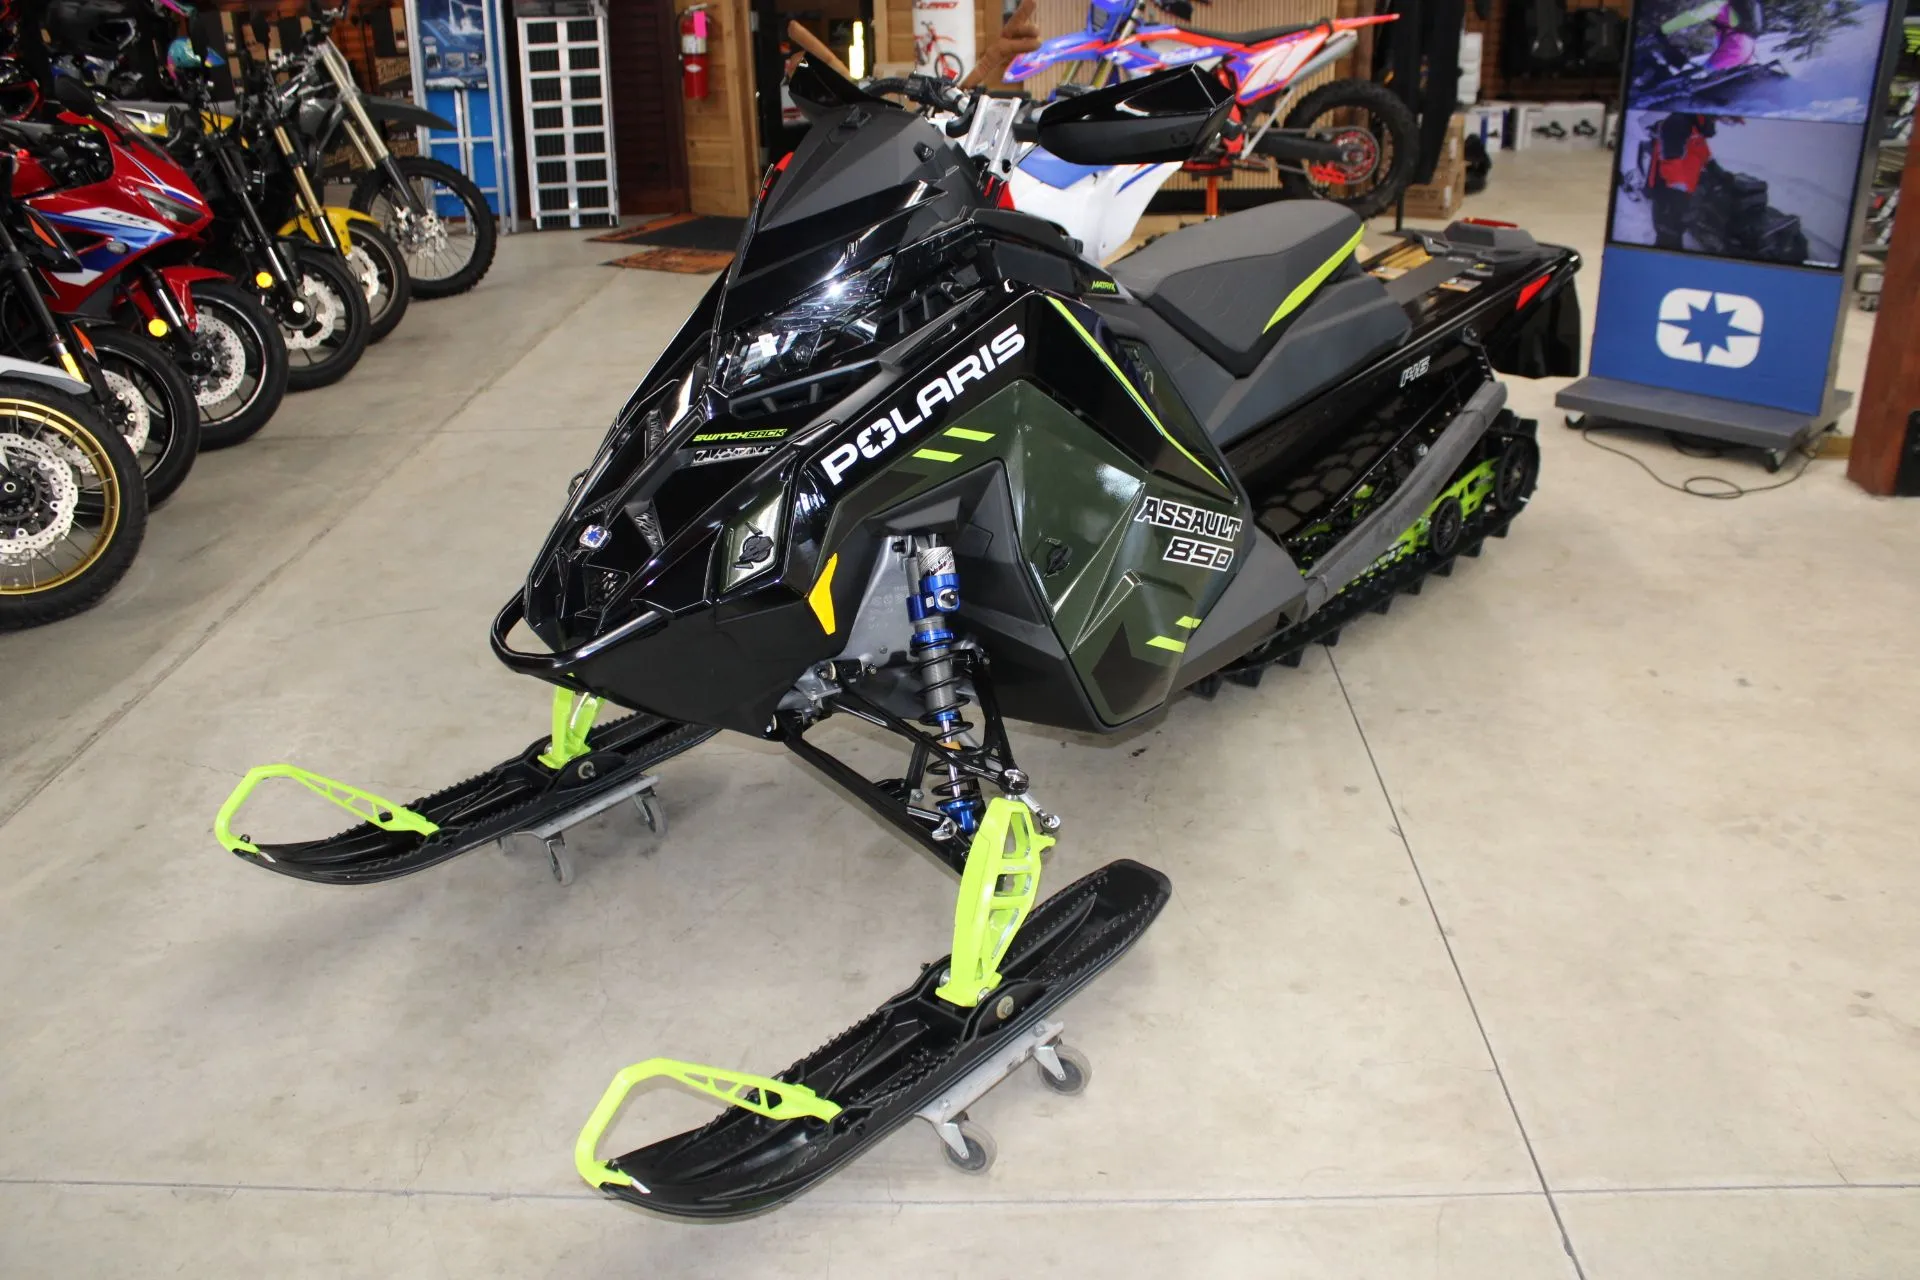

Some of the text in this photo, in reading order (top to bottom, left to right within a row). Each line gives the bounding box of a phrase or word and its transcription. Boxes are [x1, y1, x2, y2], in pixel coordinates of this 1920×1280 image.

[1399, 355, 1431, 388] 146
[820, 323, 1026, 486] POLARIS
[693, 429, 788, 442] SWITCHBACK
[1134, 496, 1242, 541] ASSAULT
[1163, 536, 1234, 572] 850
